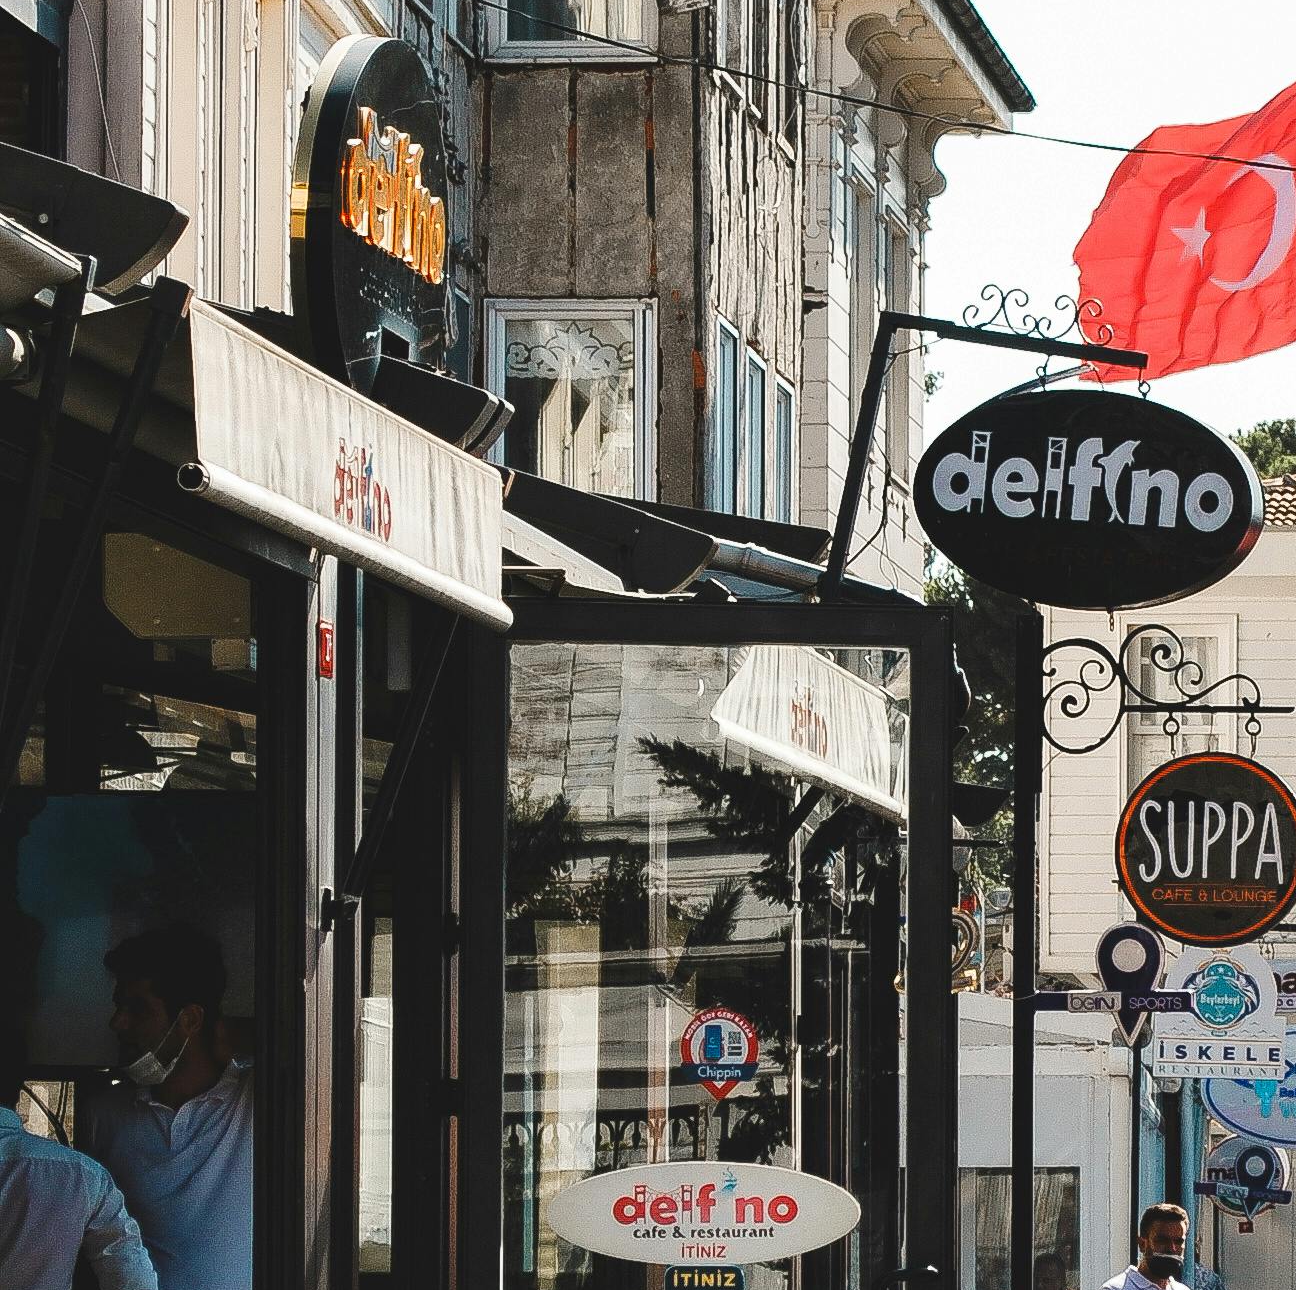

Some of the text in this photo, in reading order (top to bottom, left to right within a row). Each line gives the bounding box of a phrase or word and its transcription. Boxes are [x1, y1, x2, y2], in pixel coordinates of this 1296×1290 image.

[932, 429, 1234, 532] delfino
[1139, 799, 1284, 885] SUPPA
[1152, 888, 1278, 903] CAFE & LOUNGE
[1129, 996, 1182, 1010] SPORTS
[1158, 1040, 1281, 1062] İSKELE
[698, 1065, 742, 1080] Chippin
[1158, 1064, 1280, 1077] RESTAURANT
[633, 1226, 775, 1239] cafe & restaurant
[681, 1243, 727, 1259] İTİNİZ
[673, 1269, 736, 1288] İTİNİZ
